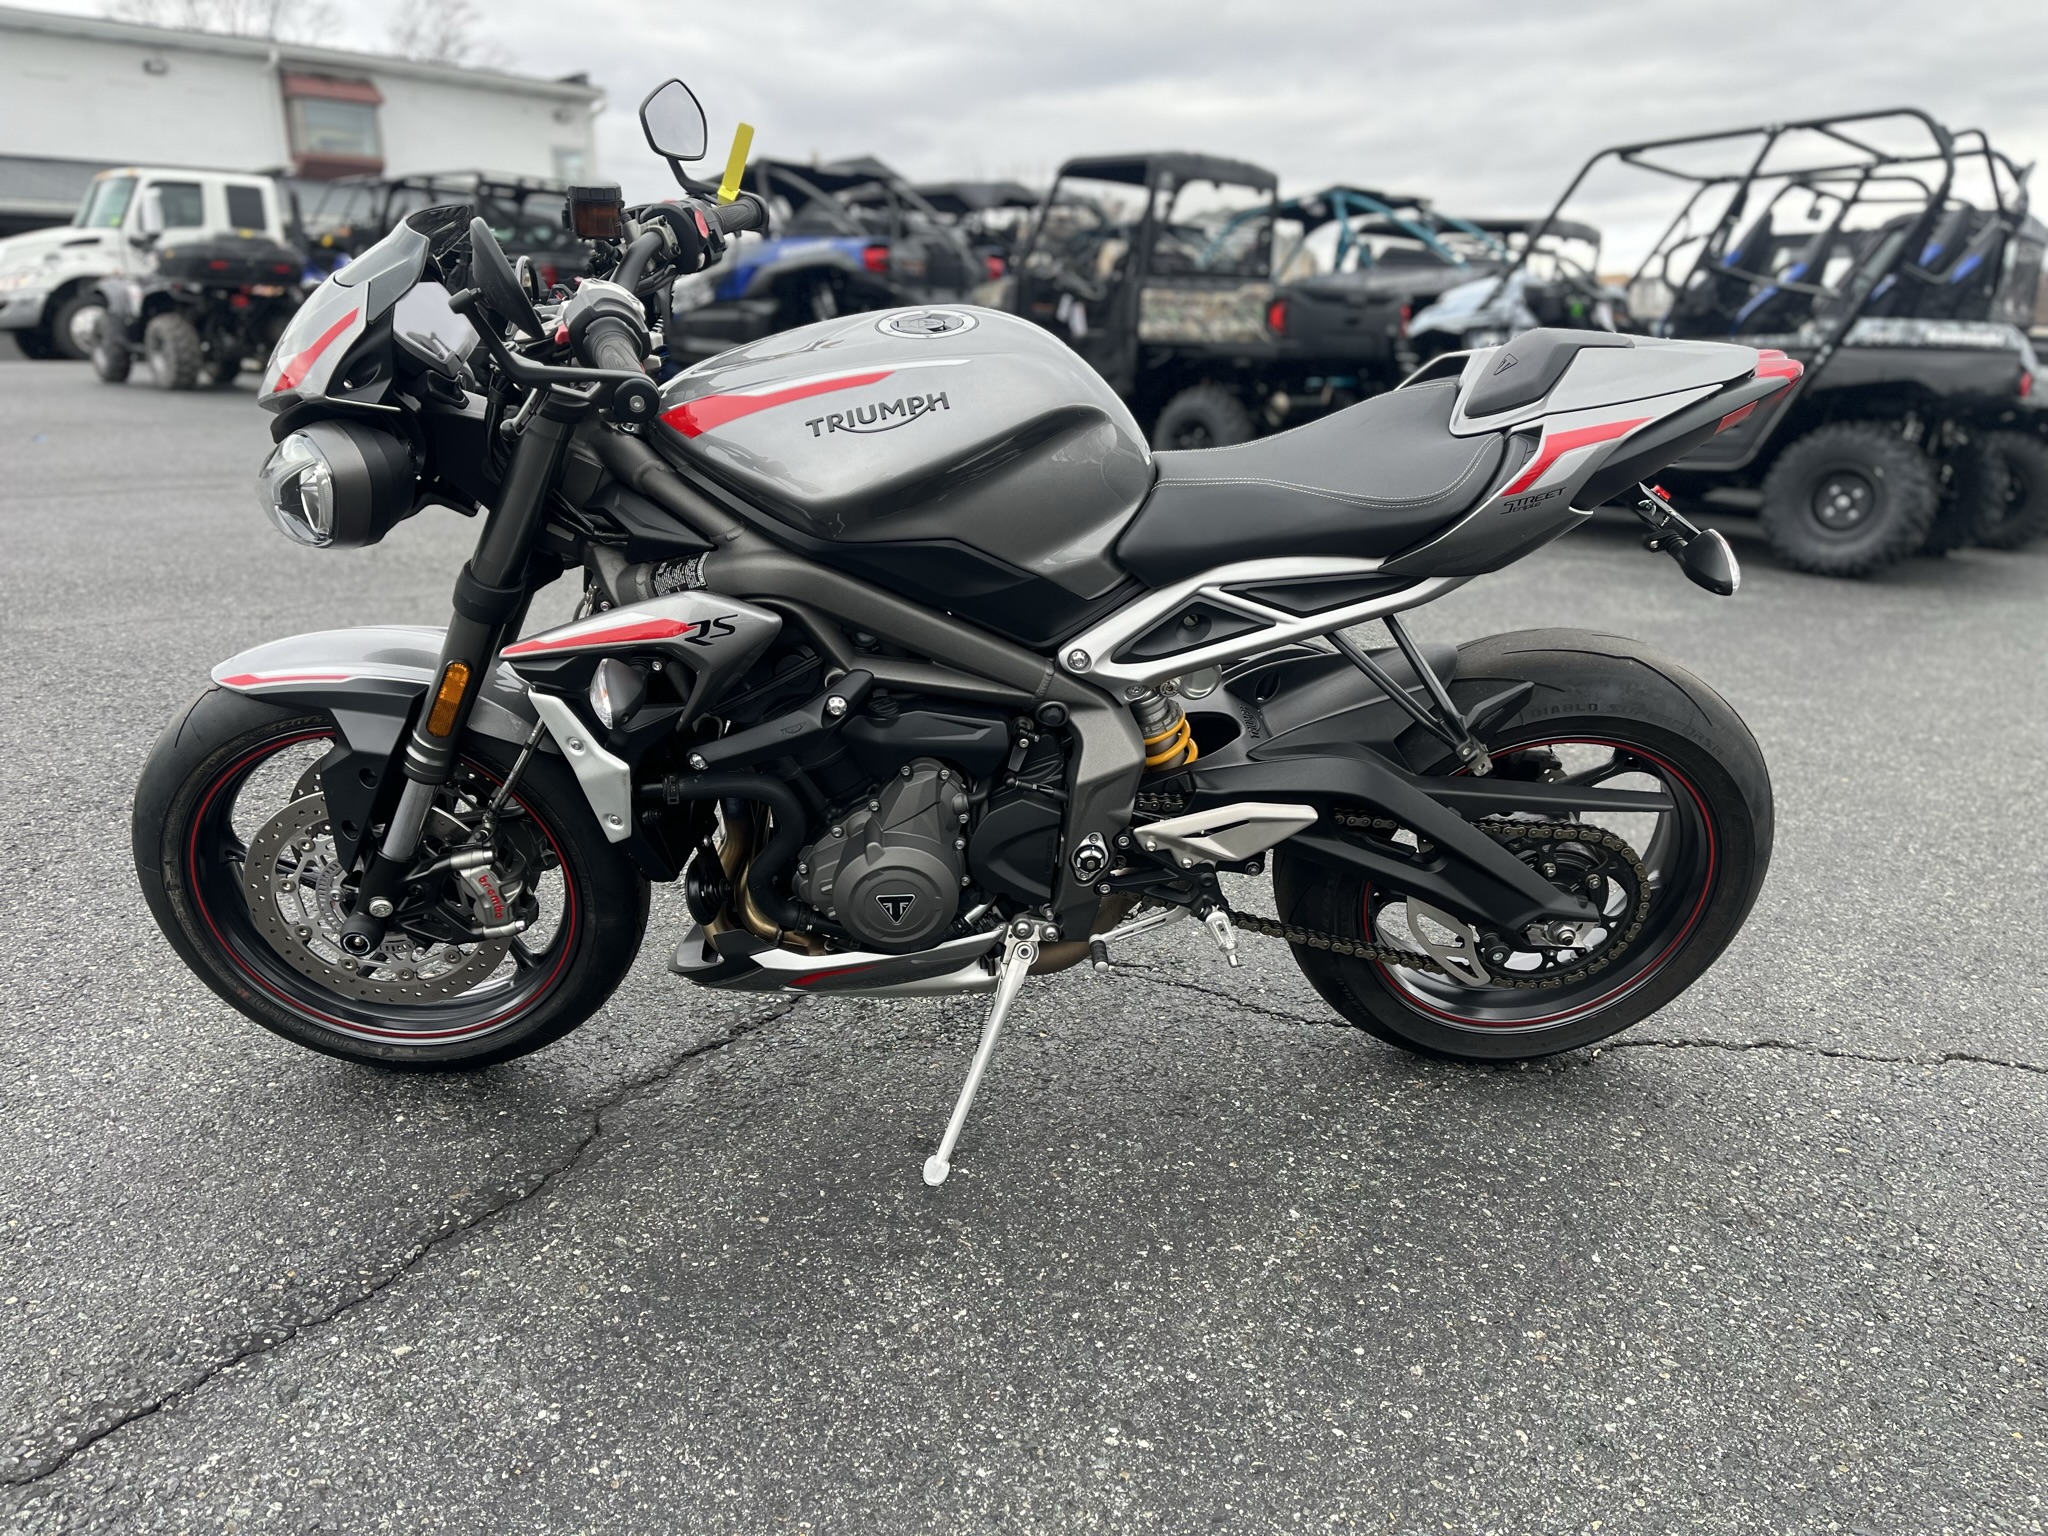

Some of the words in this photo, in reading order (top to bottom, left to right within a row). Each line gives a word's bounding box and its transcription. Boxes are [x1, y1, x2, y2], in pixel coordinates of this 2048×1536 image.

[805, 391, 950, 438] TRIUMPH
[1500, 487, 1567, 515] STREET
[684, 614, 738, 646] RS
[1530, 702, 1599, 720] DIABLO
[479, 874, 505, 919] brembo
